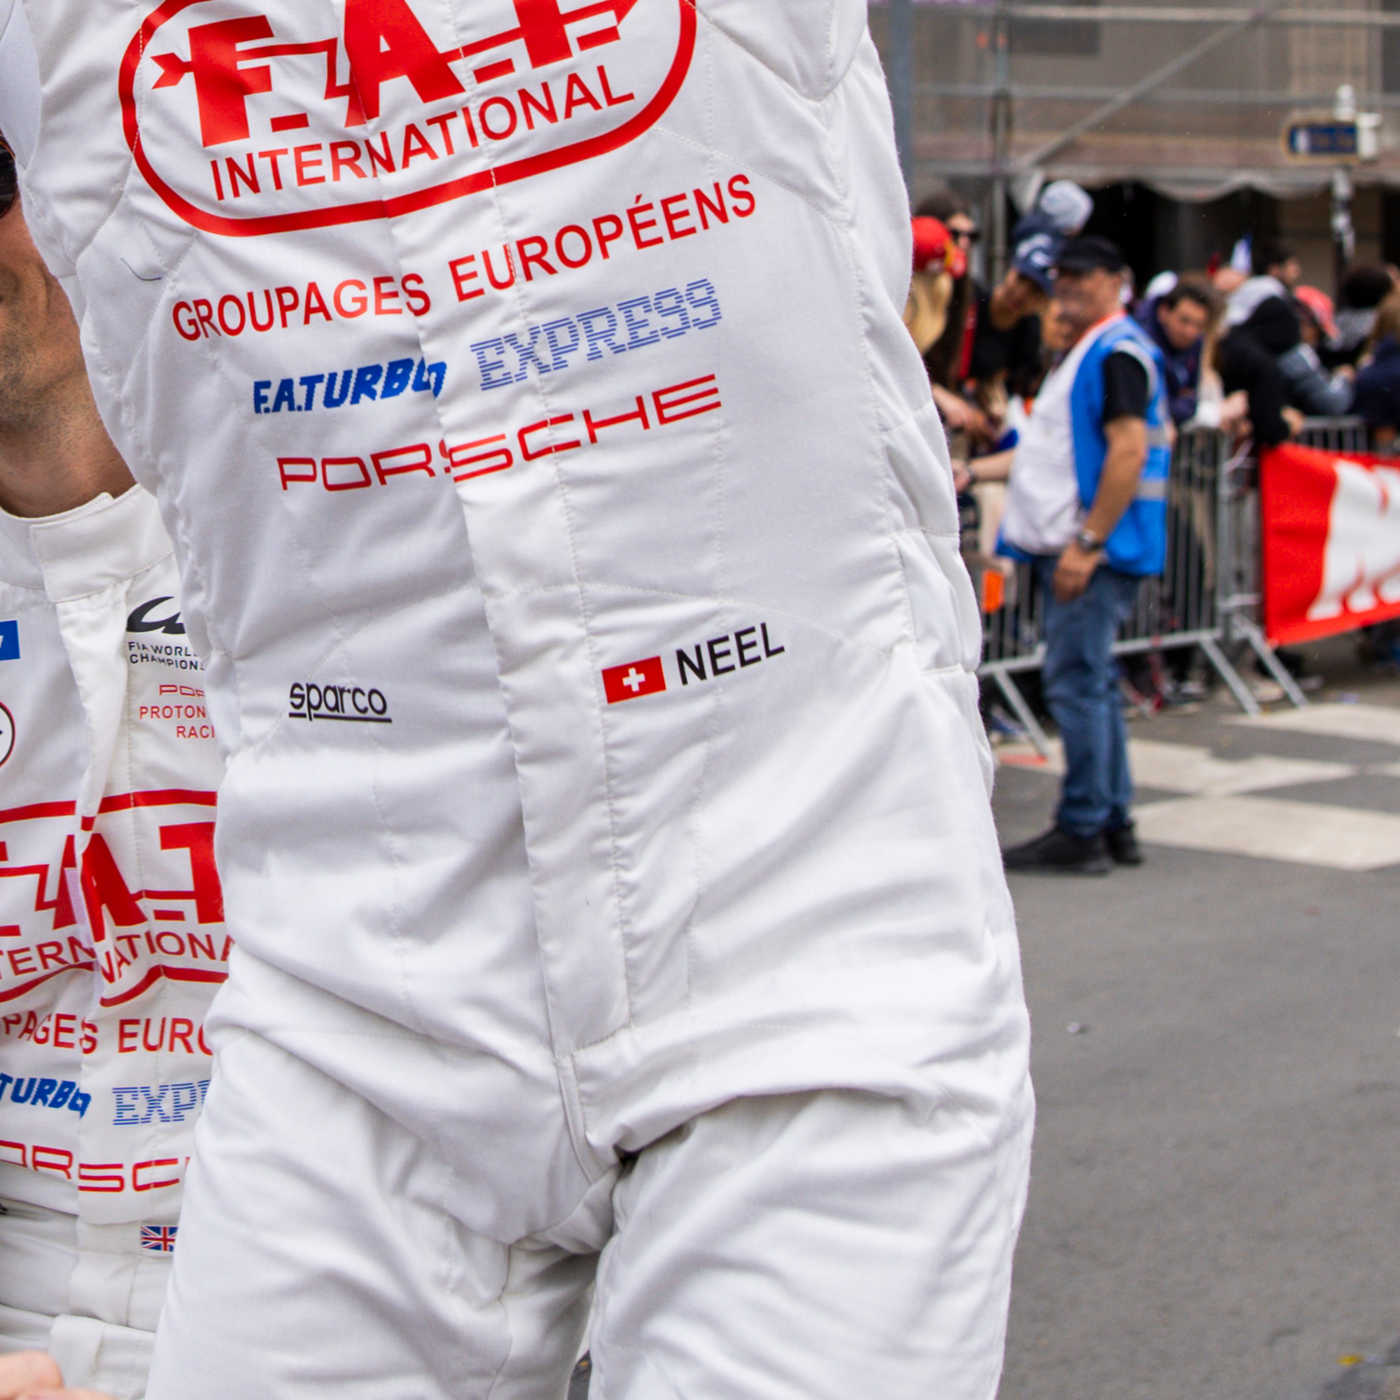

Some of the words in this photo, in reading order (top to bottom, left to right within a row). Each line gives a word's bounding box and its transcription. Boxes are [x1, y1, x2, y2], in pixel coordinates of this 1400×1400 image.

[210, 63, 635, 202] INTERNATIONAL
[172, 272, 432, 342] GROUPAGES
[449, 173, 756, 302] EUROPÉENS
[469, 278, 722, 392] EXPRESS
[277, 373, 722, 492] PORSCHE
[150, 644, 198, 658] WORL
[676, 622, 785, 687] NEEL
[139, 704, 207, 720] PROTON
[288, 679, 392, 722] sparco
